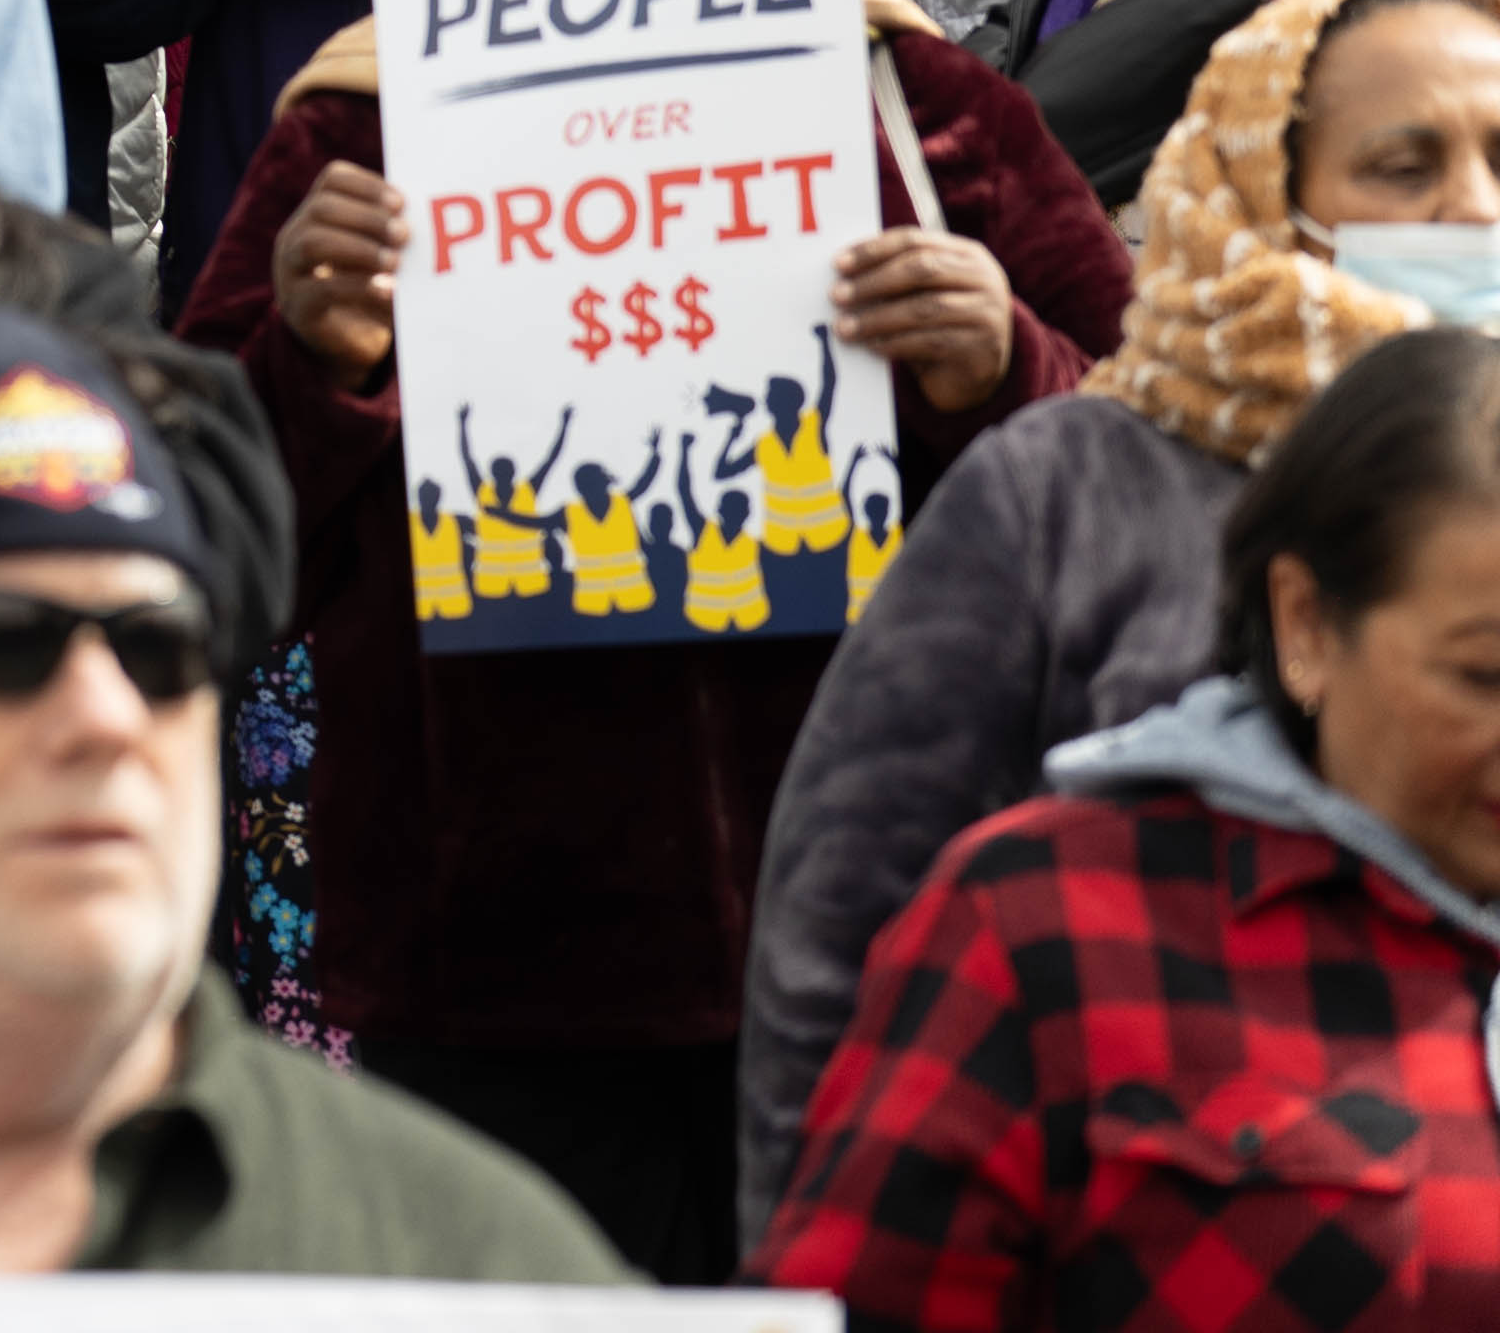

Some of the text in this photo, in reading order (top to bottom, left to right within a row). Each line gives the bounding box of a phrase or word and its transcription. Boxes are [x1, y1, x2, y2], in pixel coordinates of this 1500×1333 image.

[563, 102, 692, 147] OVER
[430, 153, 833, 274] PROFIT
[571, 276, 716, 362] $$$
